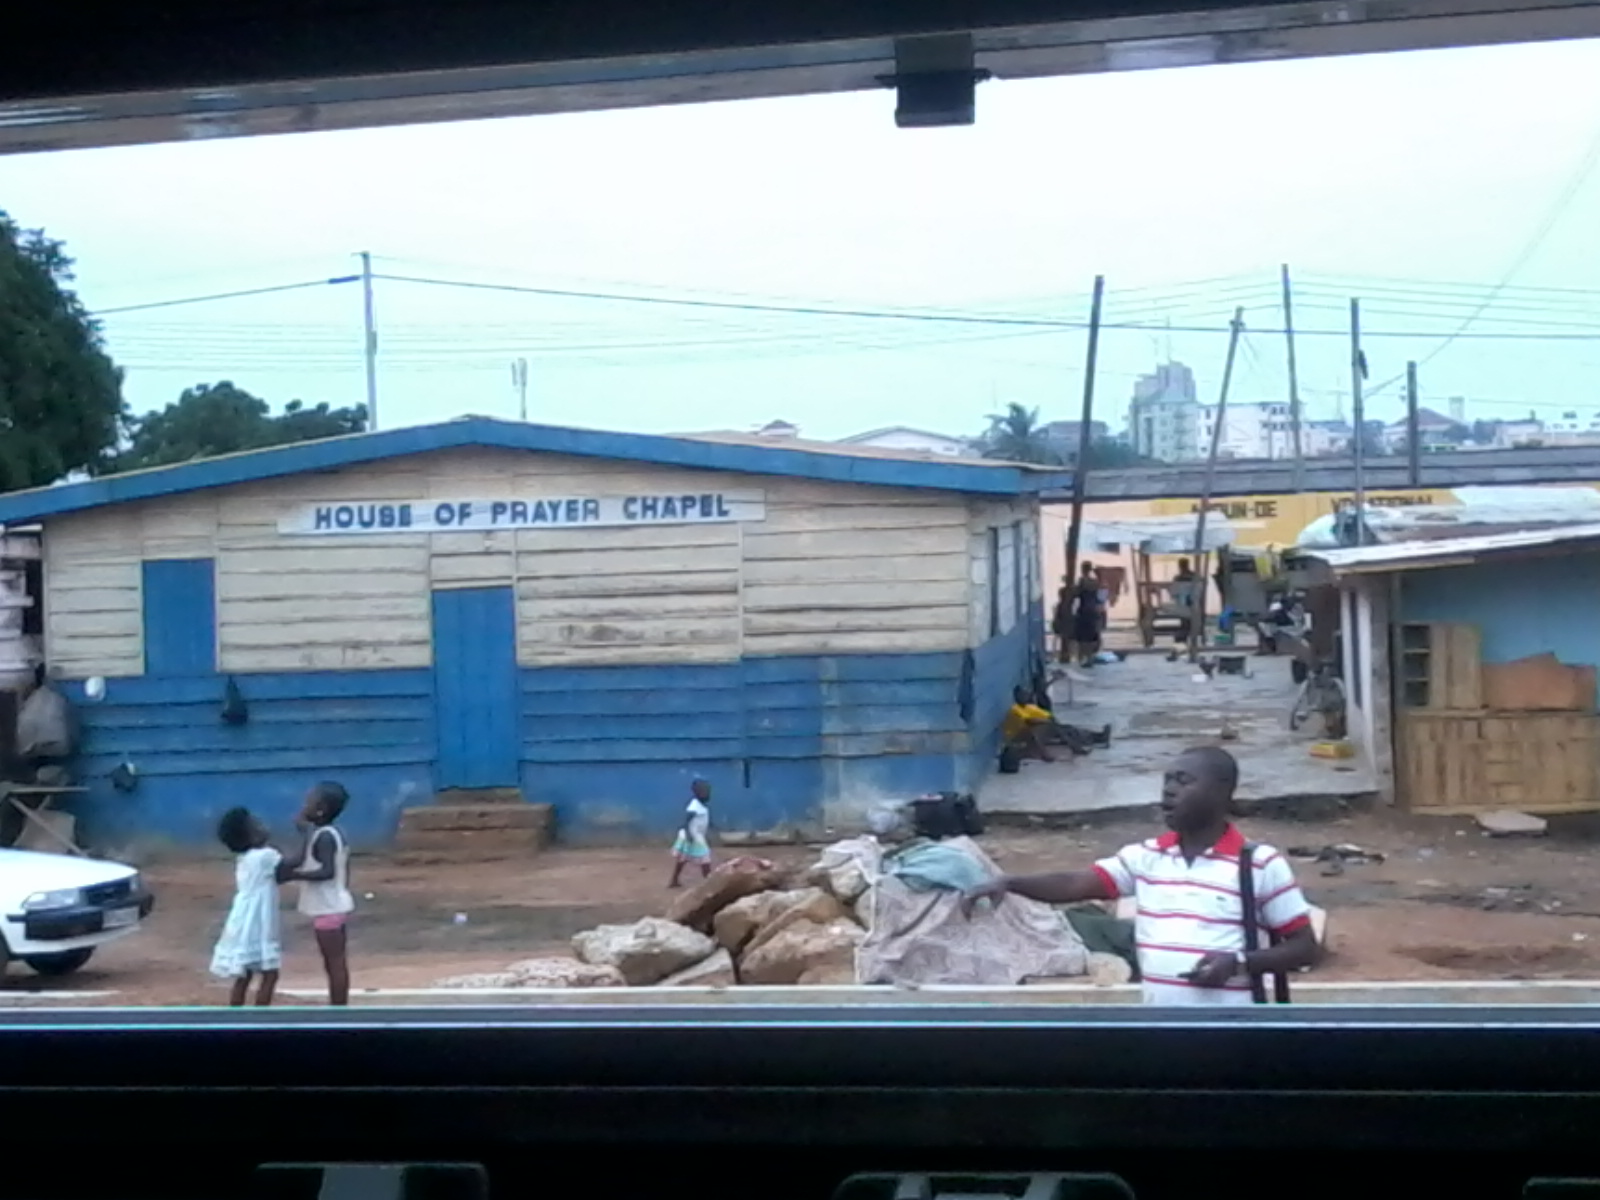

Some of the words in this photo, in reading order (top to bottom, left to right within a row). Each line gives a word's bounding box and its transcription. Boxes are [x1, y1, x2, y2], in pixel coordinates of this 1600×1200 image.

[315, 504, 412, 529] HOUSE
[434, 503, 472, 525] OF
[491, 499, 600, 524] PRAYER
[622, 494, 730, 519] CHAPEL
